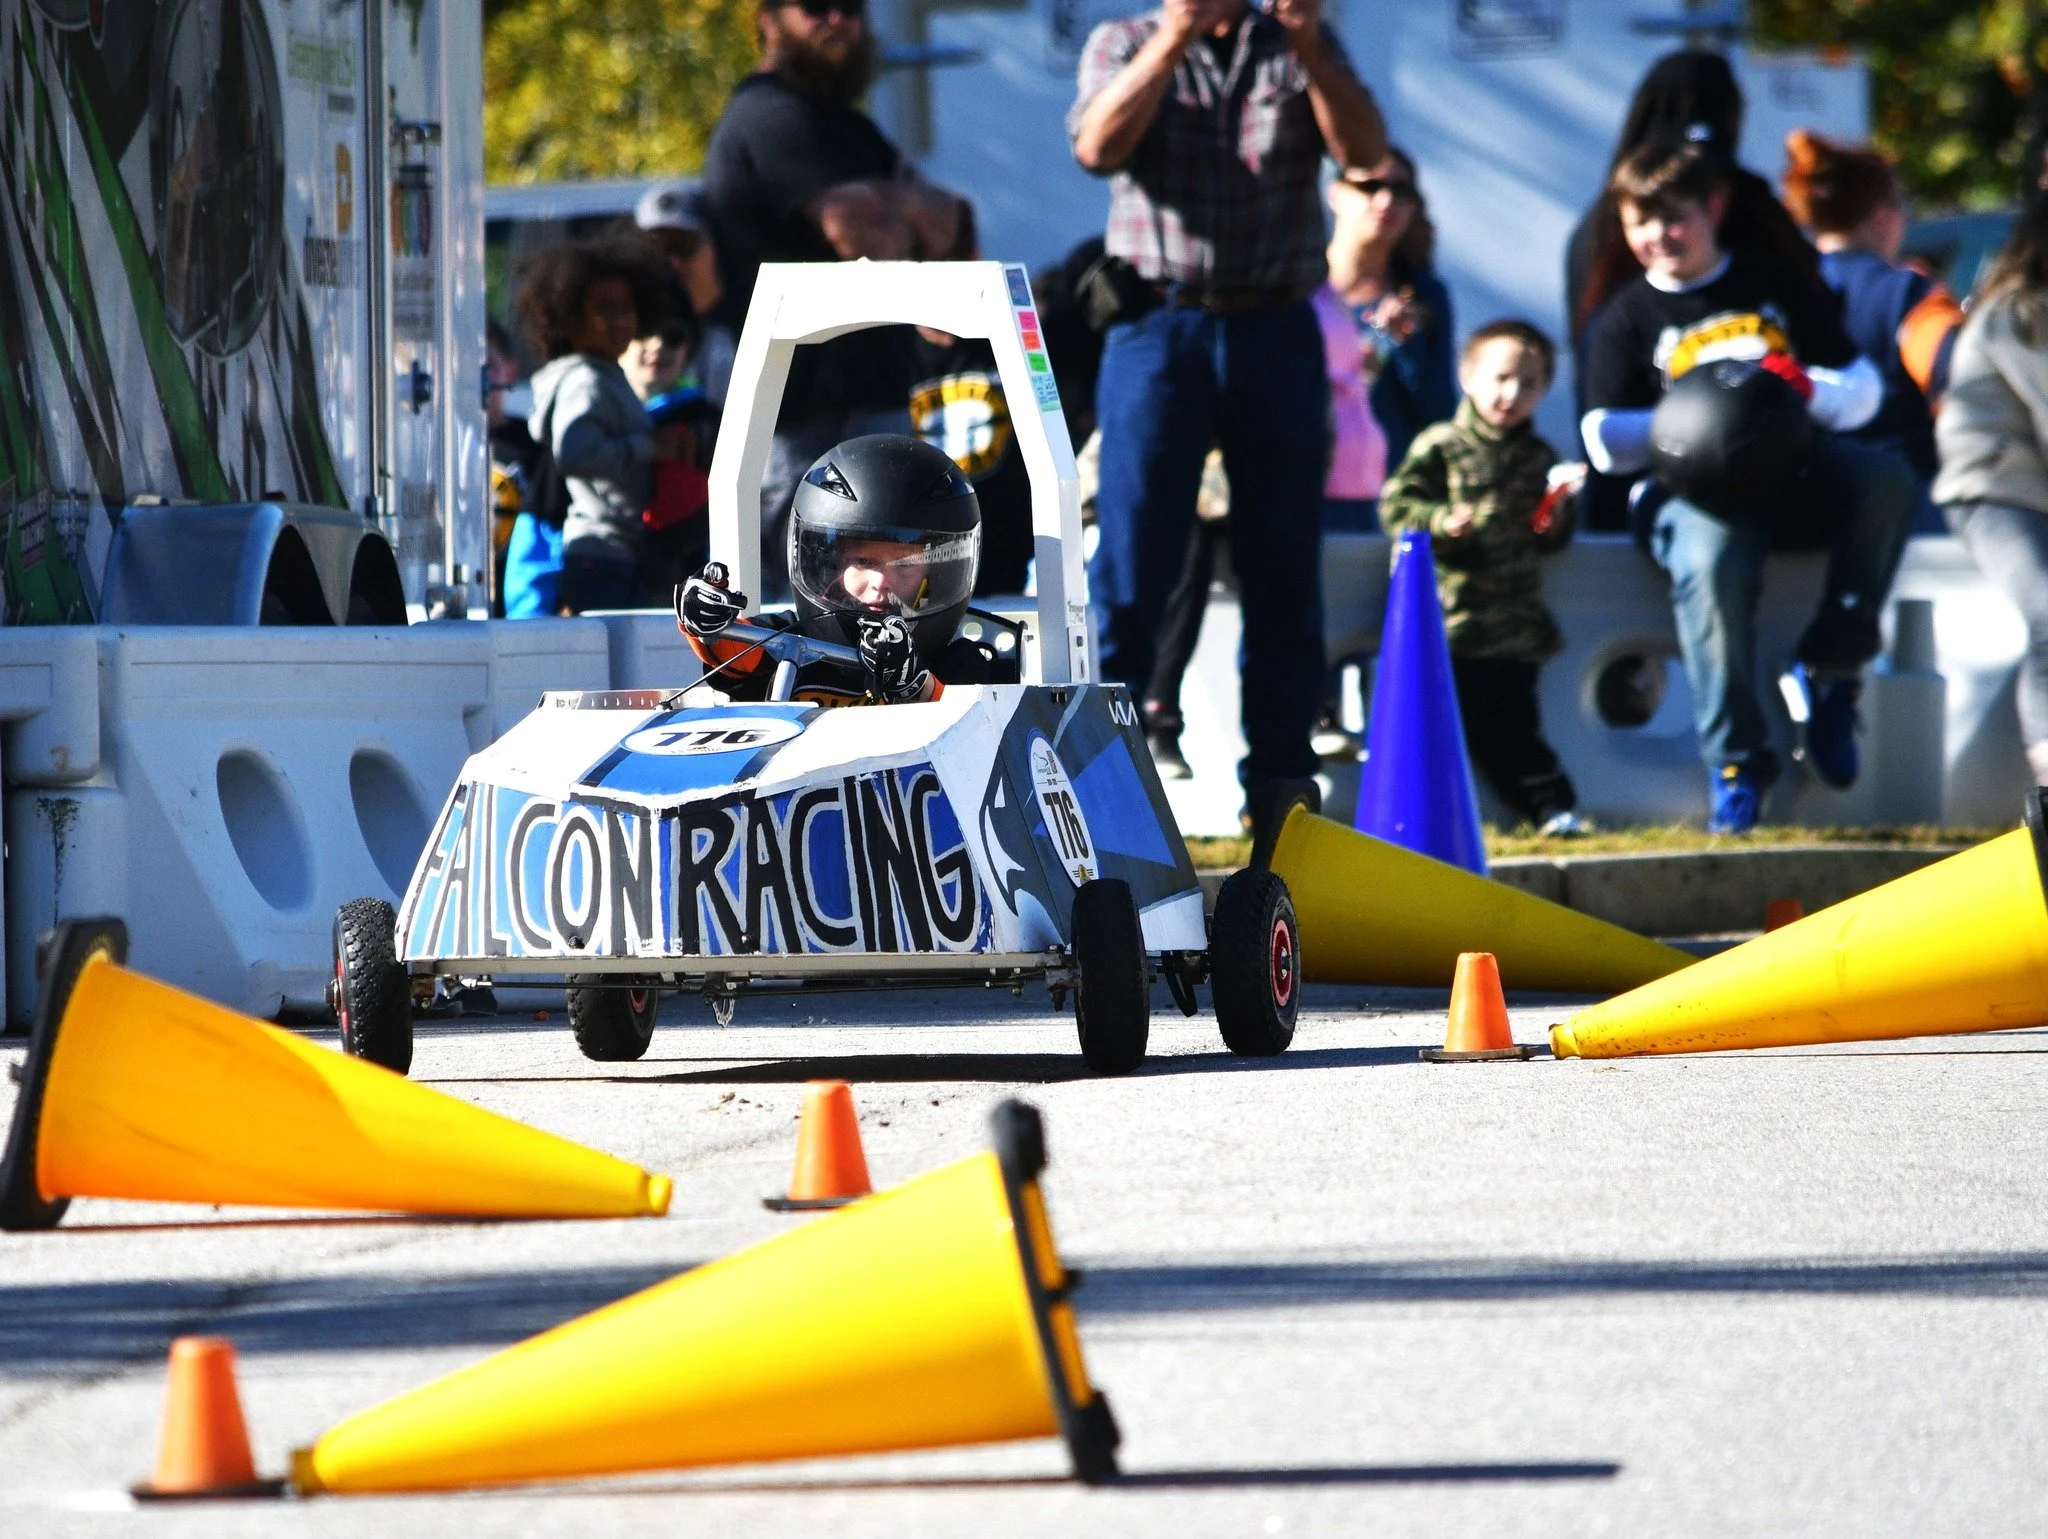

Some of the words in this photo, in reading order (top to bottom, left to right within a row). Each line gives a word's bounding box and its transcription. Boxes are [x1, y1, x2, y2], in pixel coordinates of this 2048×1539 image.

[652, 729, 771, 748] 776
[1041, 789, 1090, 860] 776
[400, 779, 654, 958] FALCON
[677, 767, 979, 956] RACING
